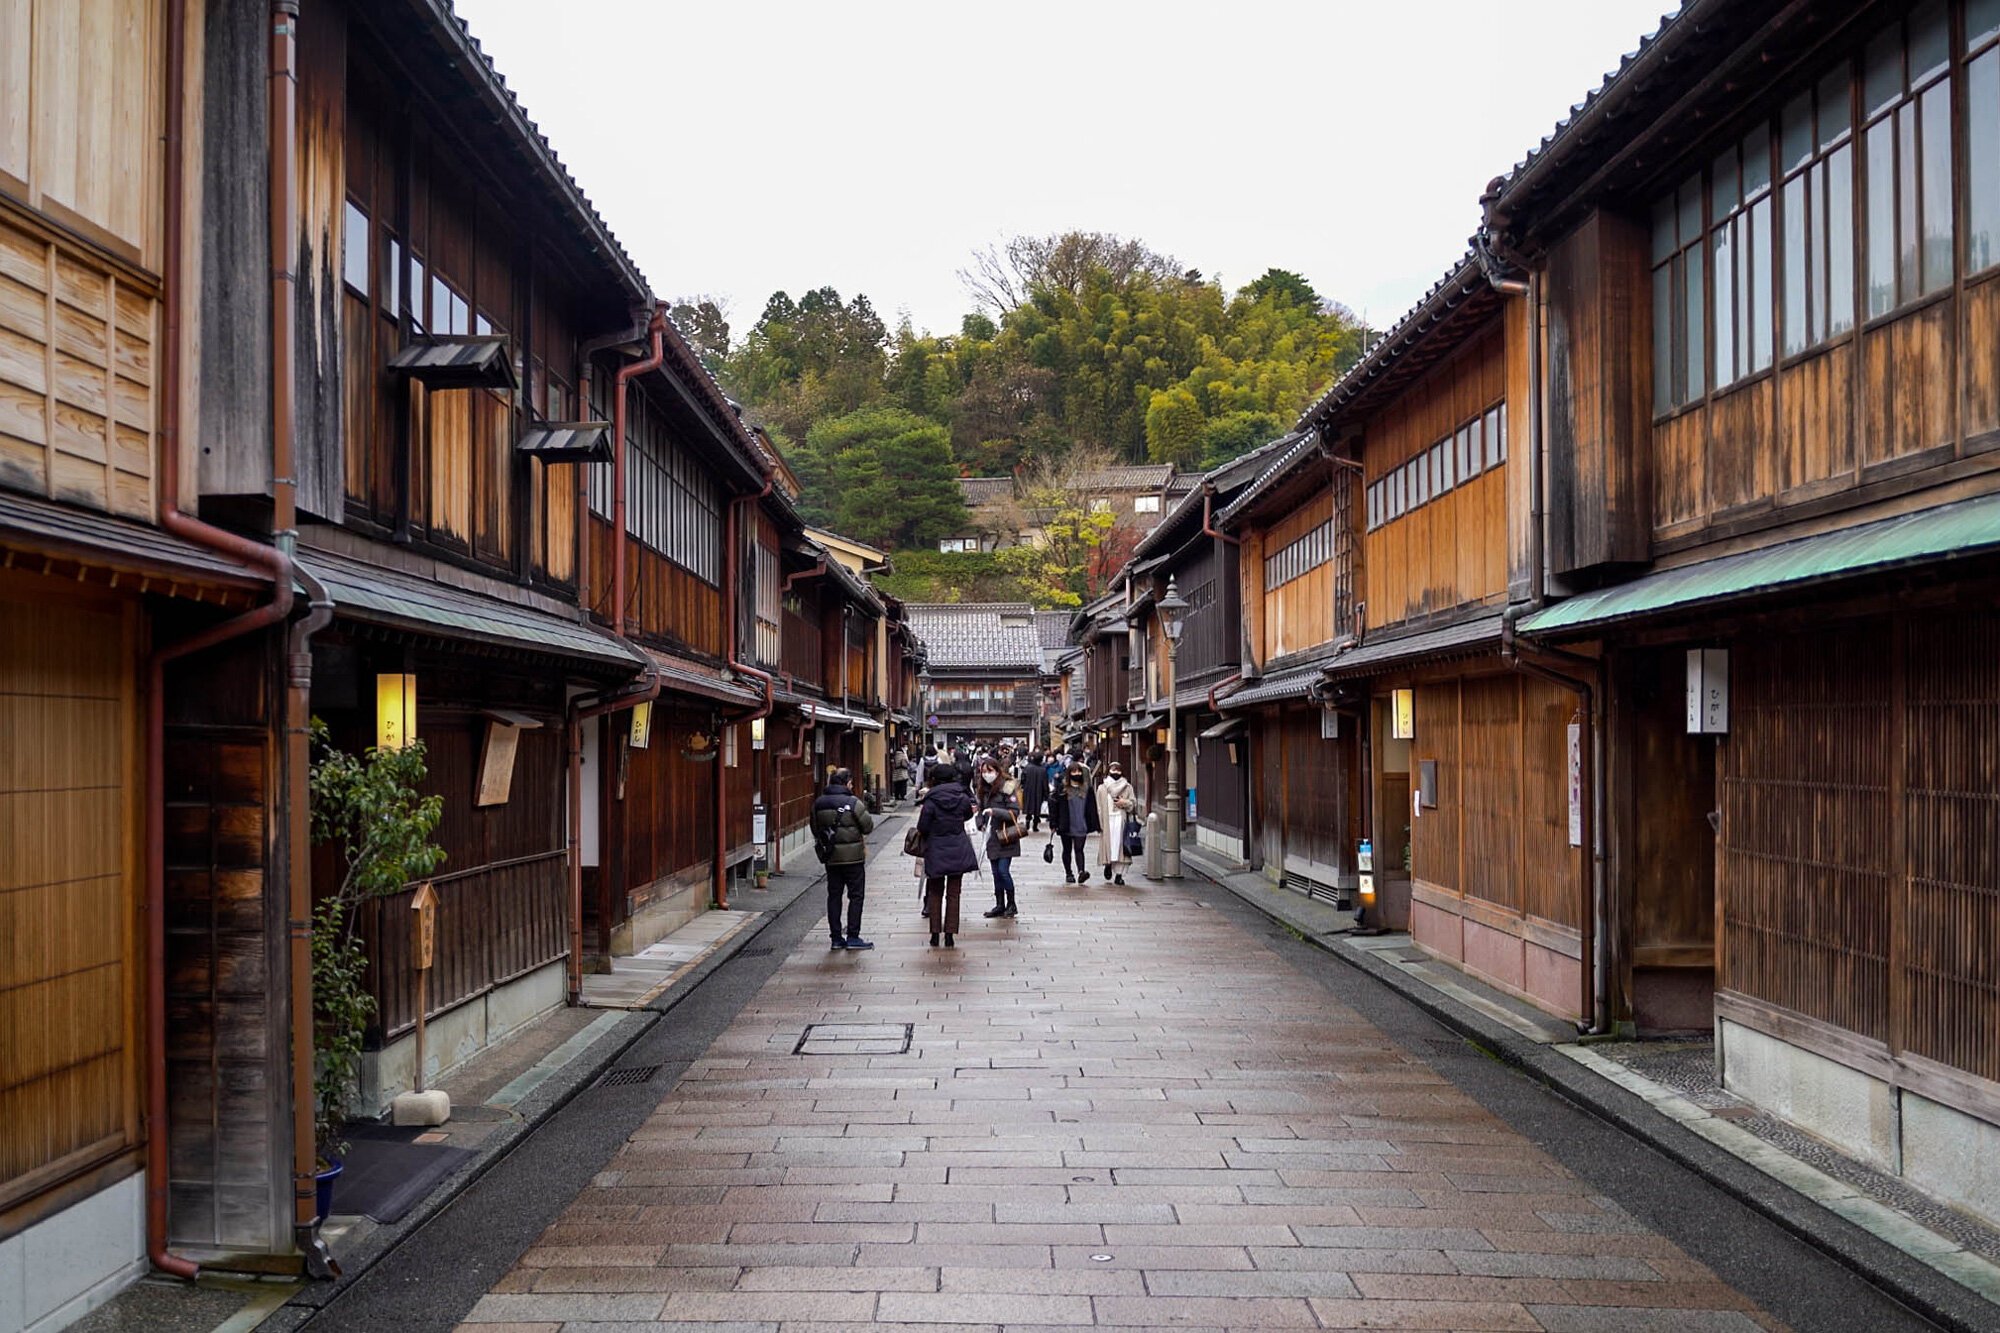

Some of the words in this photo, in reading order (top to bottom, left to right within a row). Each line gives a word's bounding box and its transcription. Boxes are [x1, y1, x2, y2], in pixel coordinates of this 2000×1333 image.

[1710, 689, 1720, 726] ひがし
[634, 720, 642, 742] ひがし
